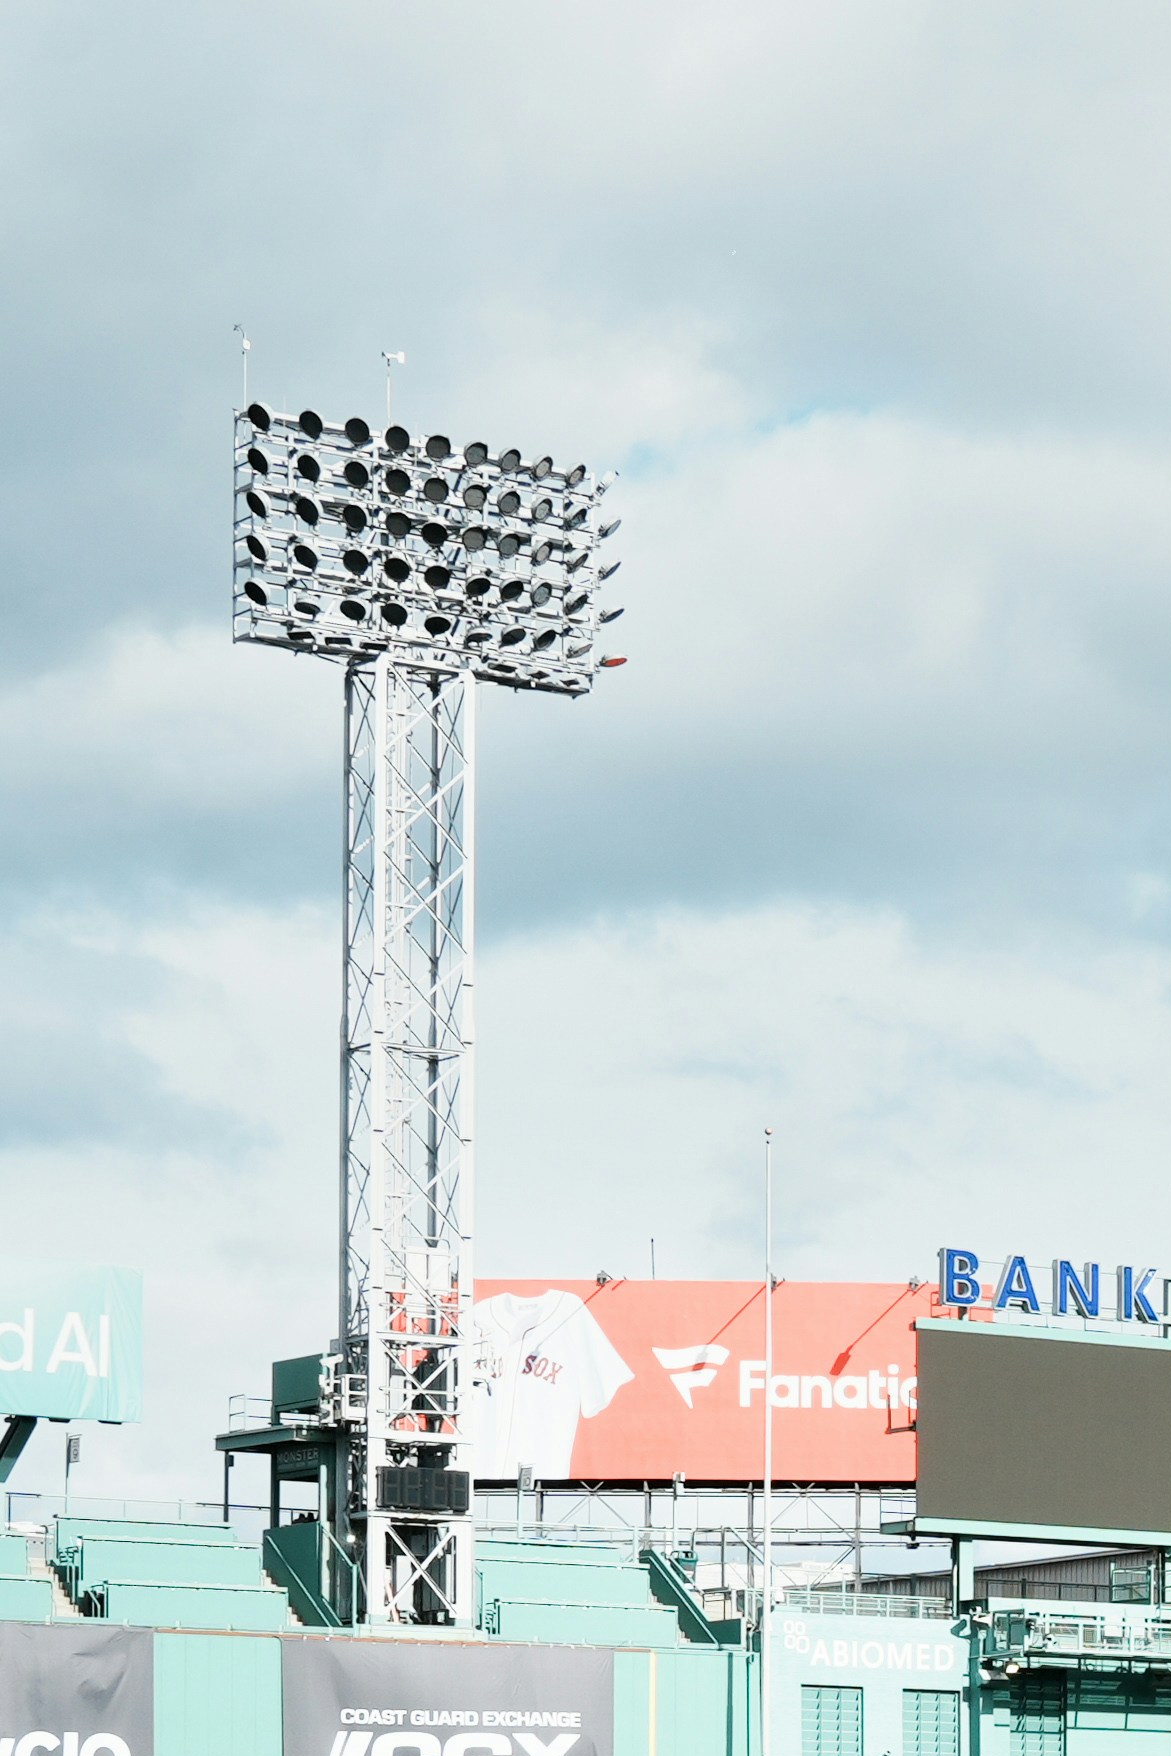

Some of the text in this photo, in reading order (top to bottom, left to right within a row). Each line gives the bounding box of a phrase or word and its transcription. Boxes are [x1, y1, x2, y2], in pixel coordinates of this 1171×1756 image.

[937, 1248, 1160, 1326] BANK
[46, 1311, 110, 1378] AI
[522, 1354, 564, 1385] SOX
[277, 1447, 319, 1463] MONSTER
[811, 1639, 955, 1672] ABIOMED
[340, 1709, 582, 1738] COAST GUARD EXCHANGE
